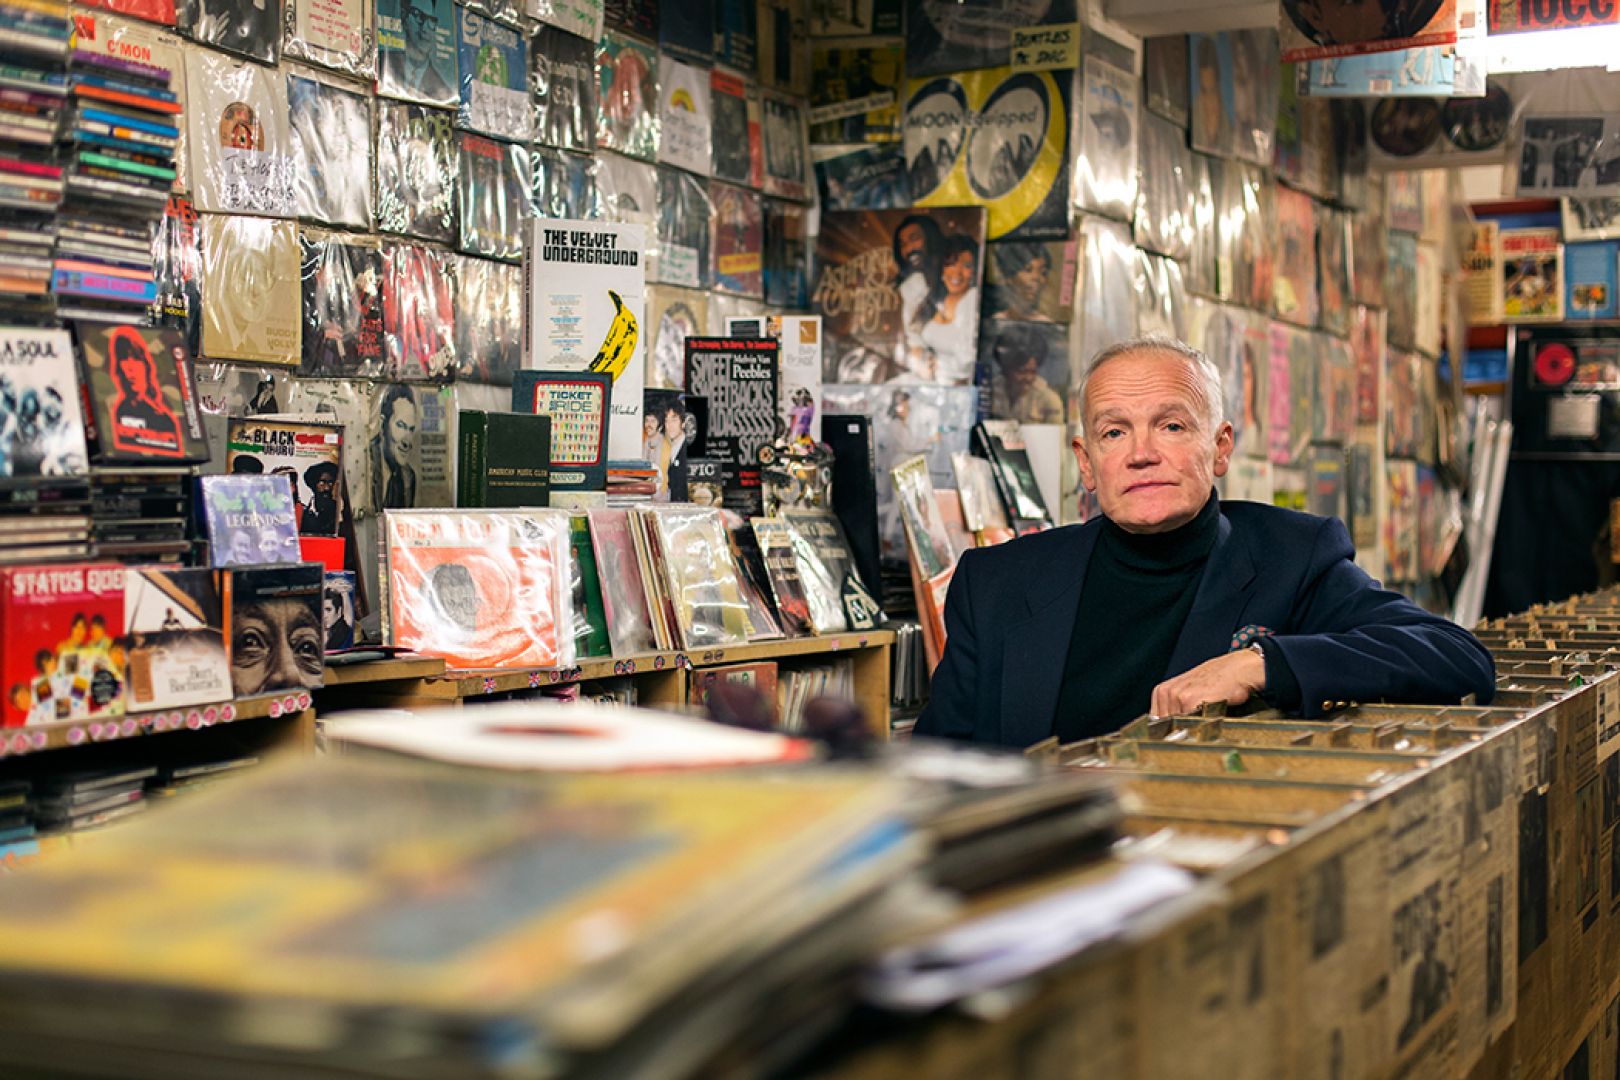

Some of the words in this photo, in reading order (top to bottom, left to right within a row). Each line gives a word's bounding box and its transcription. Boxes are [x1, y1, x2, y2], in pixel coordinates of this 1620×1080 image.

[107, 39, 151, 60] C'MON
[543, 229, 568, 246] THE
[570, 231, 618, 249] VELVET
[542, 245, 638, 267] UNDERGROUND
[266, 338, 297, 350] HOLLY
[733, 364, 771, 378] Peebles
[549, 391, 593, 400] TICKET
[555, 401, 593, 412] RIDE
[254, 429, 295, 445] BLACK
[225, 513, 279, 528] LEGENDS
[13, 570, 83, 596] STATUS
